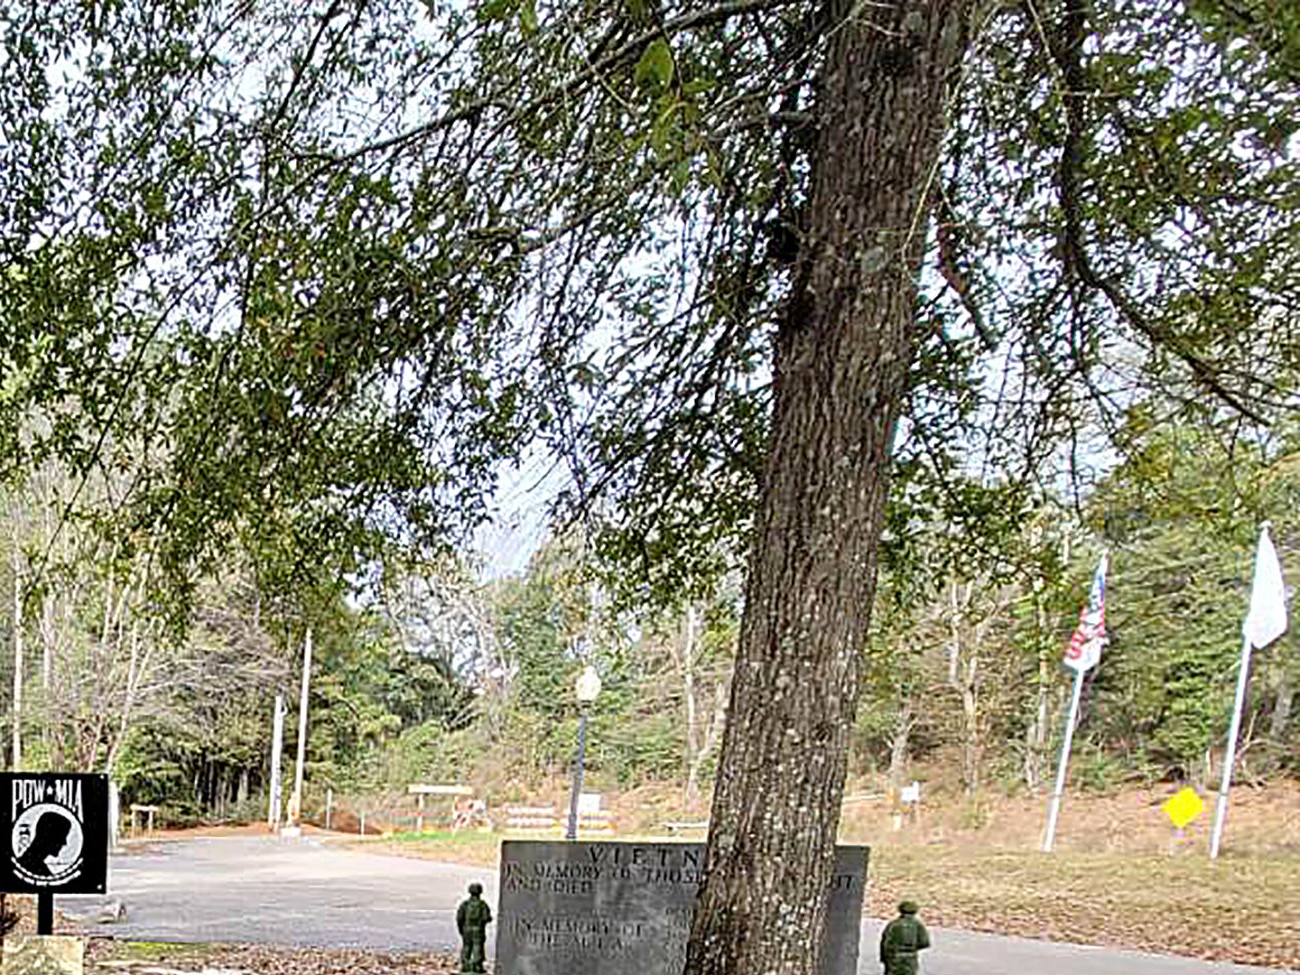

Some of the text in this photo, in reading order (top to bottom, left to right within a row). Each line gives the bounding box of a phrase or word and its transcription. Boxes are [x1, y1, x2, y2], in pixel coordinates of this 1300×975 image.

[11, 779, 84, 824] POW MIA
[588, 846, 700, 867] VIETN
[534, 864, 601, 879] MEMORY
[543, 918, 611, 935] MEMORY
